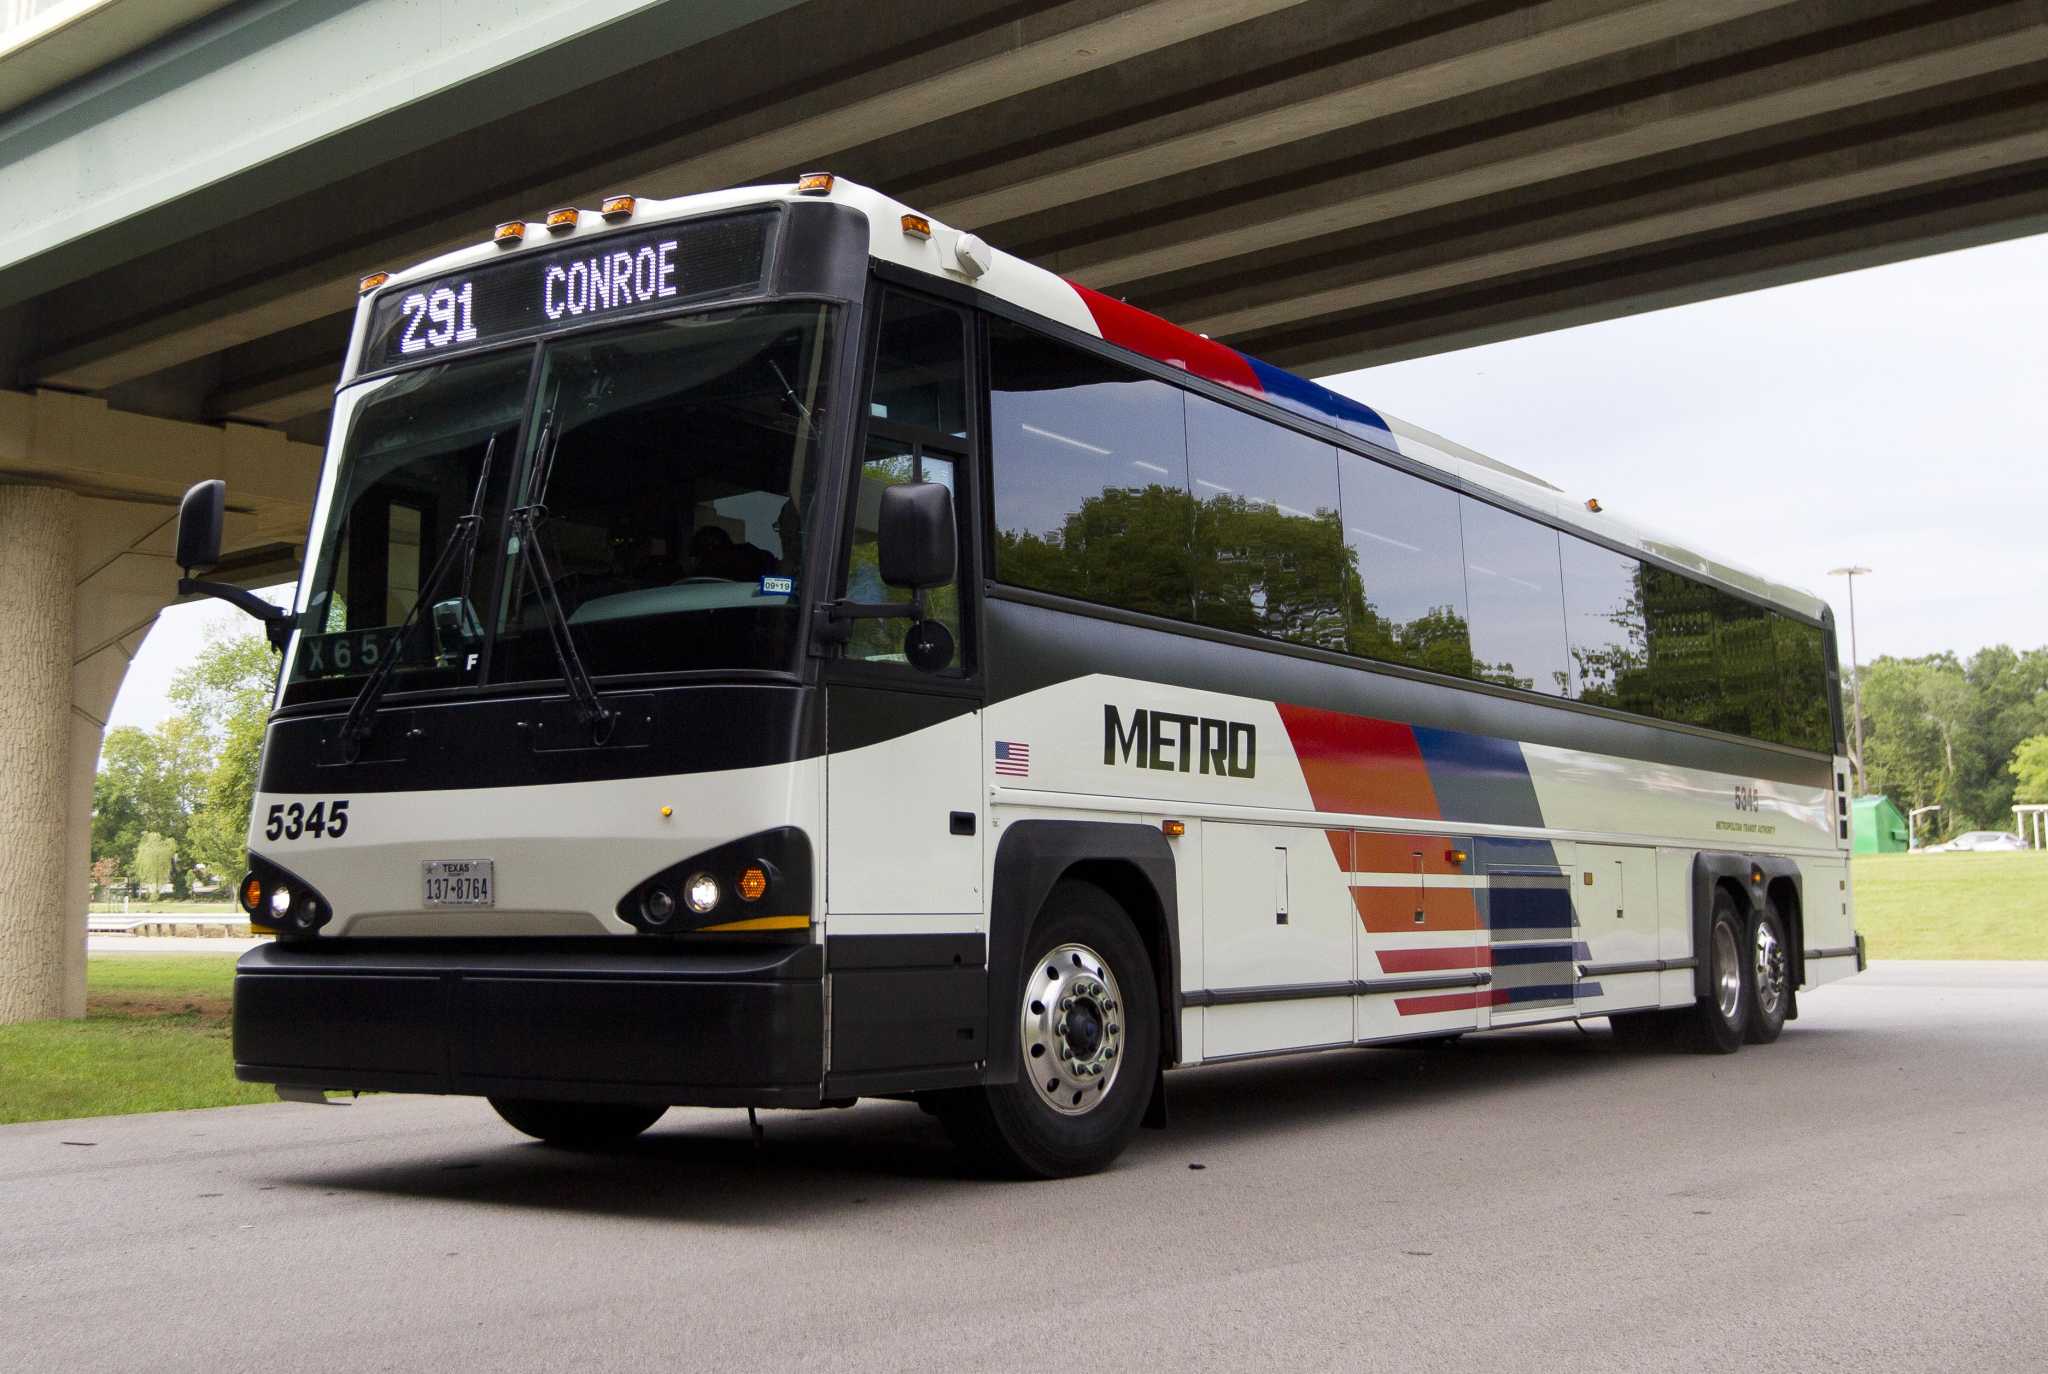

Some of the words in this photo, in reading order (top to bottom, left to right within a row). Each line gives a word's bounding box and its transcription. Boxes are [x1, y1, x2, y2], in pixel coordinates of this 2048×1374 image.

[401, 282, 477, 353] 291
[543, 240, 678, 320] CONROE
[1103, 703, 1257, 780] METRO
[265, 799, 350, 842] 5345
[1735, 786, 1758, 813] 5345
[442, 864, 469, 872] TEXAS
